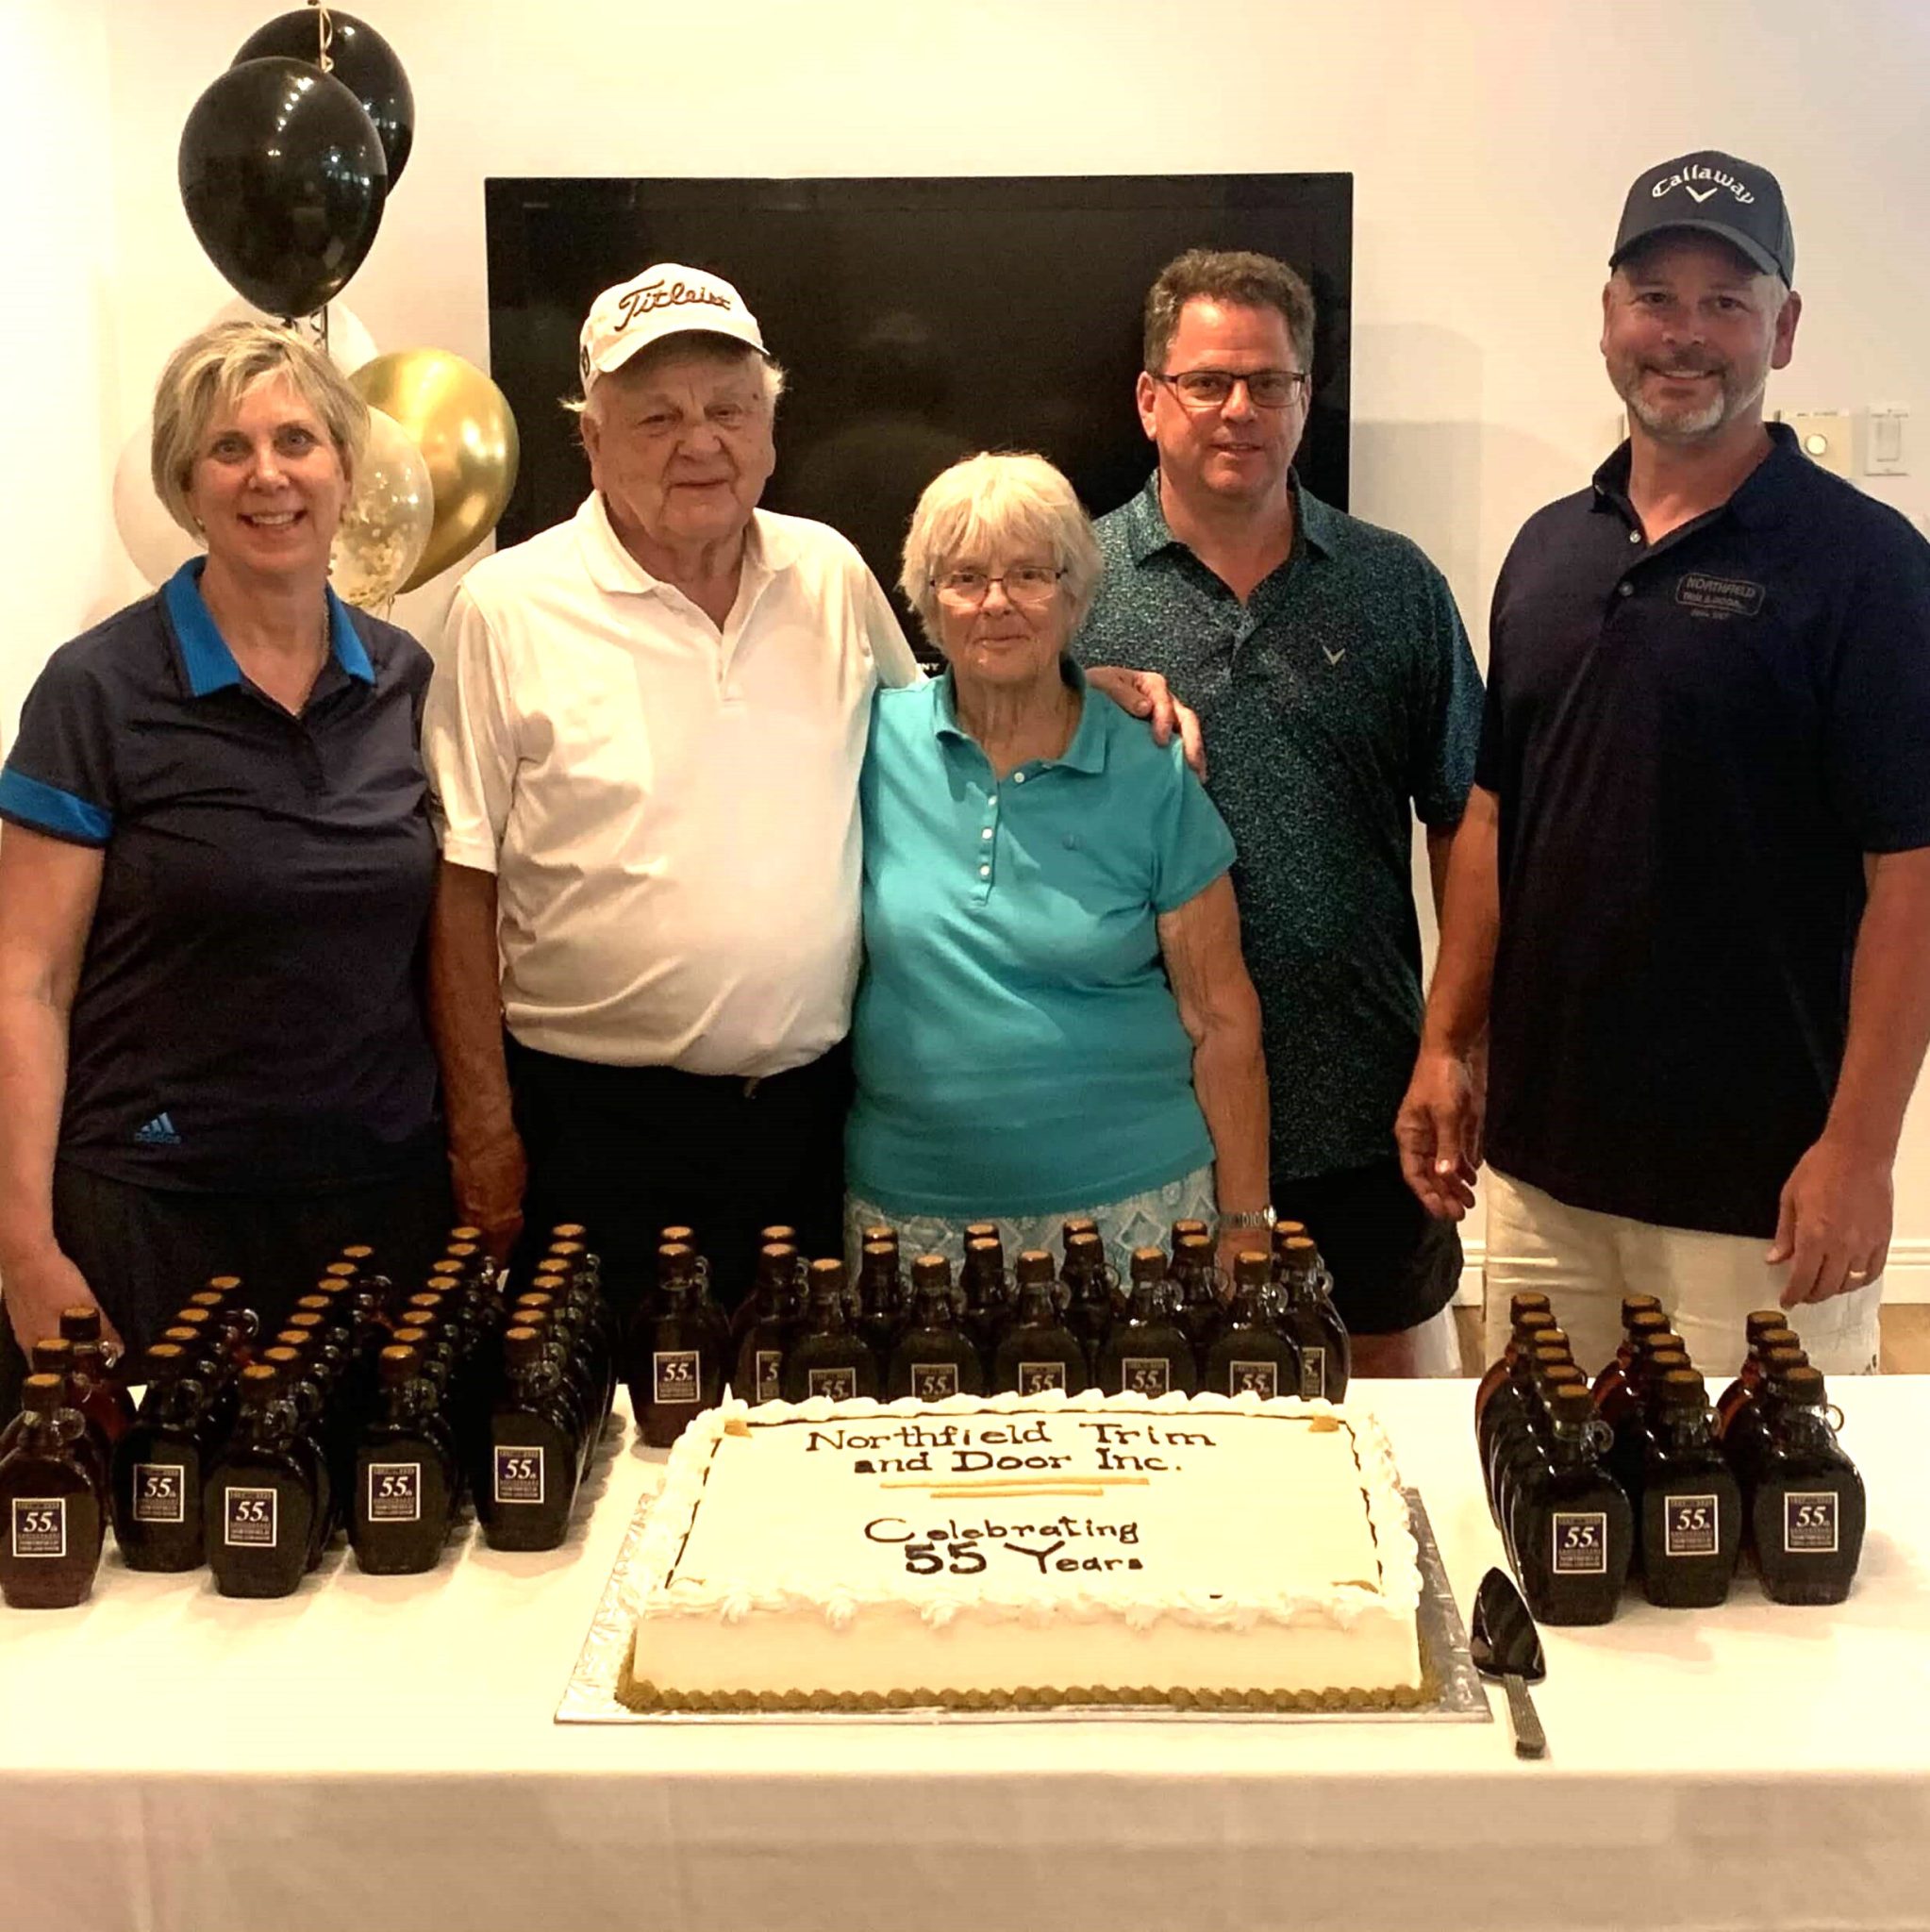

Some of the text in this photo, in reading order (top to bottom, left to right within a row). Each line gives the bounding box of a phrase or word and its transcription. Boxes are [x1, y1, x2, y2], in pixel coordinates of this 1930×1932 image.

[1652, 164, 1755, 204] Callaway
[921, 662, 940, 672] NY
[806, 1421, 1215, 1452] Northfield Trim
[855, 1448, 1183, 1473] and Door Inc.
[865, 1517, 1138, 1542] Celebrating
[905, 1541, 1142, 1574] 55 Years
